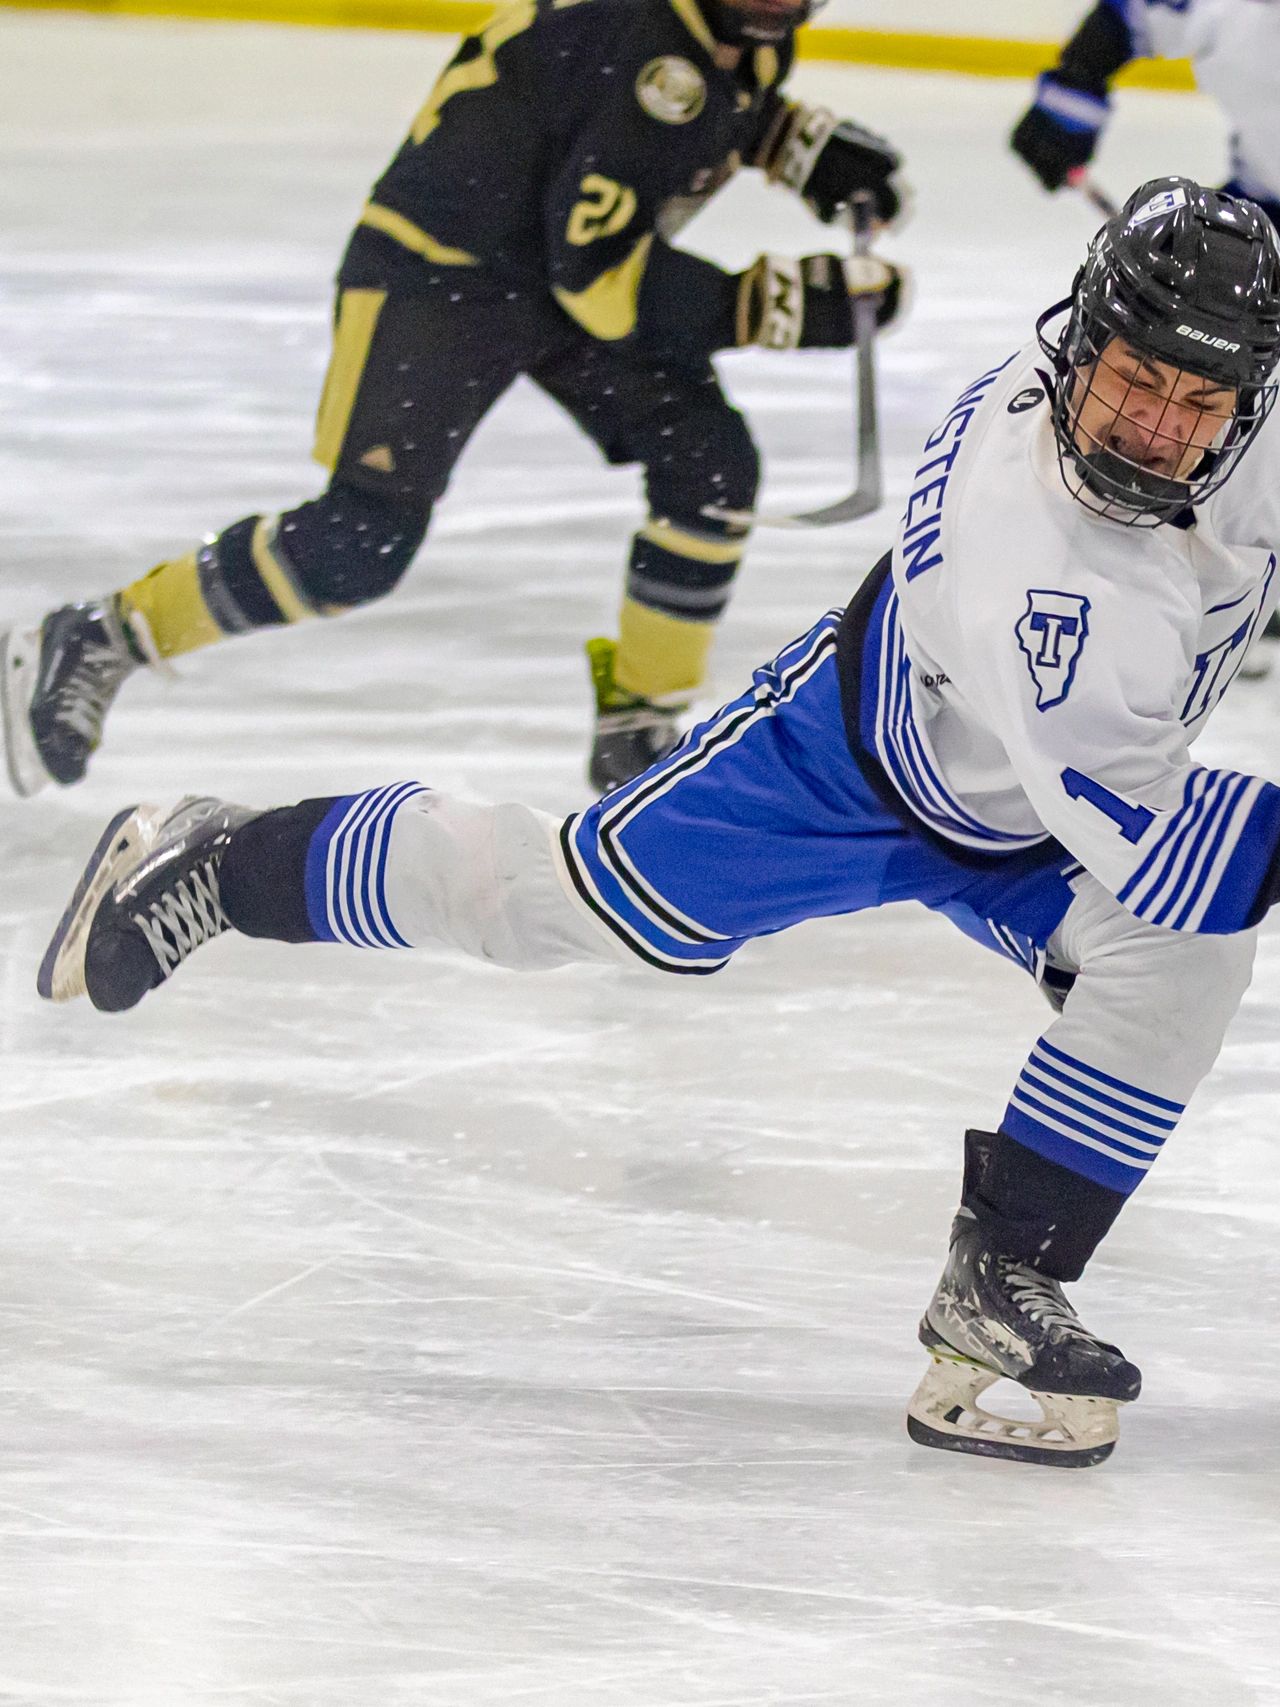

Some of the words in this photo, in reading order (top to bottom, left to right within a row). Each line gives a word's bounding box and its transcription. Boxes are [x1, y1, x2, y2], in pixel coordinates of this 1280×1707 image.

[1176, 324, 1241, 353] BAUER
[903, 351, 1021, 584] NSTEIN
[1060, 766, 1156, 845] 1
